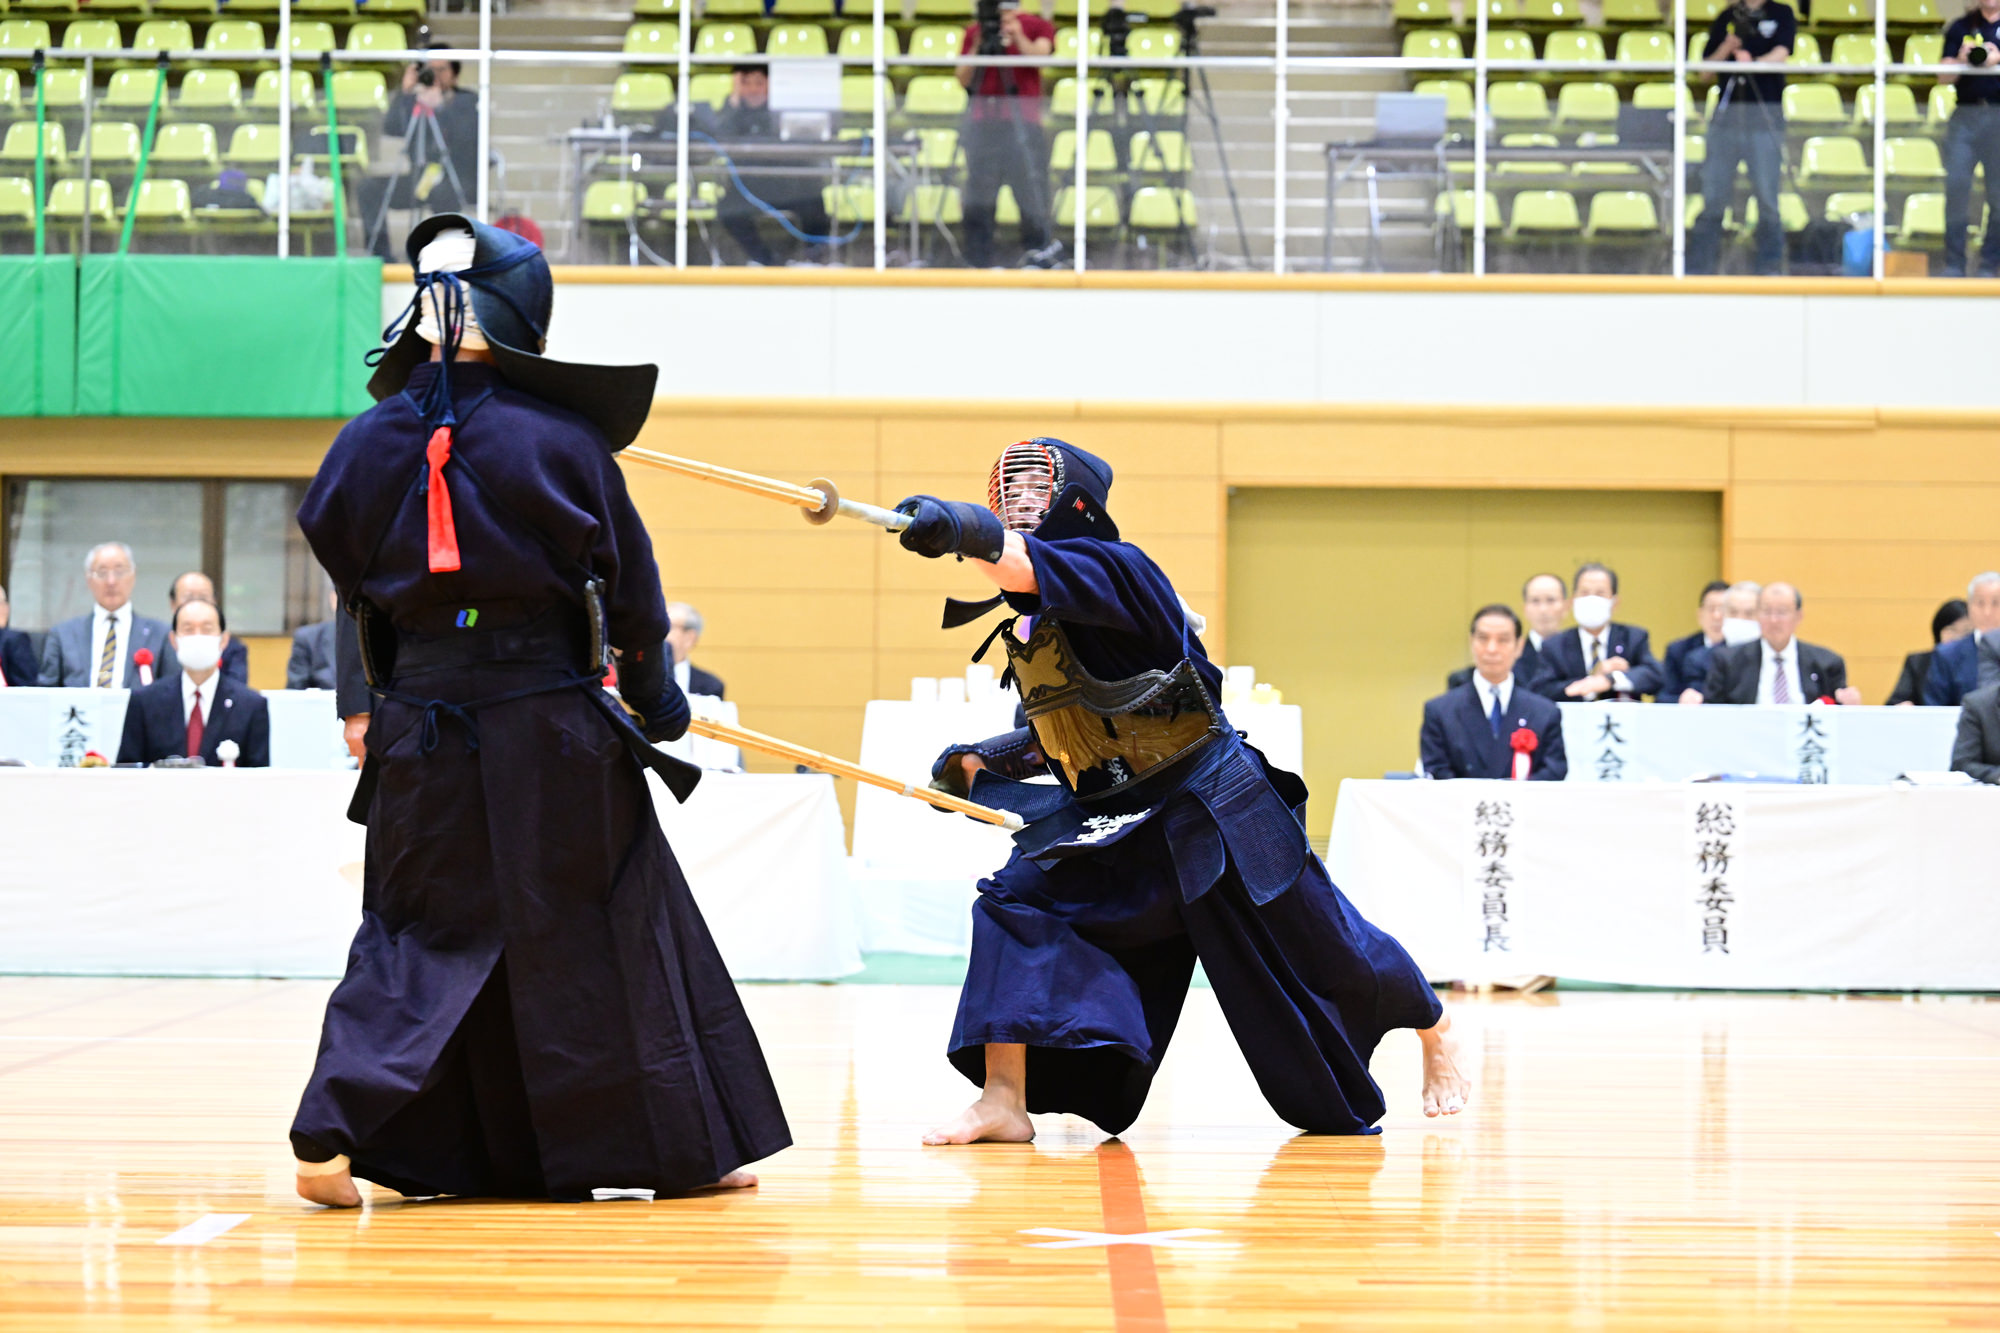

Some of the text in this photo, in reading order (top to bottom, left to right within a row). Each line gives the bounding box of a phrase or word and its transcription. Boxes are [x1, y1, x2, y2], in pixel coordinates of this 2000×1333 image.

[1474, 800, 1514, 952] 総務委員長
[1694, 802, 1736, 954] 総務委員
